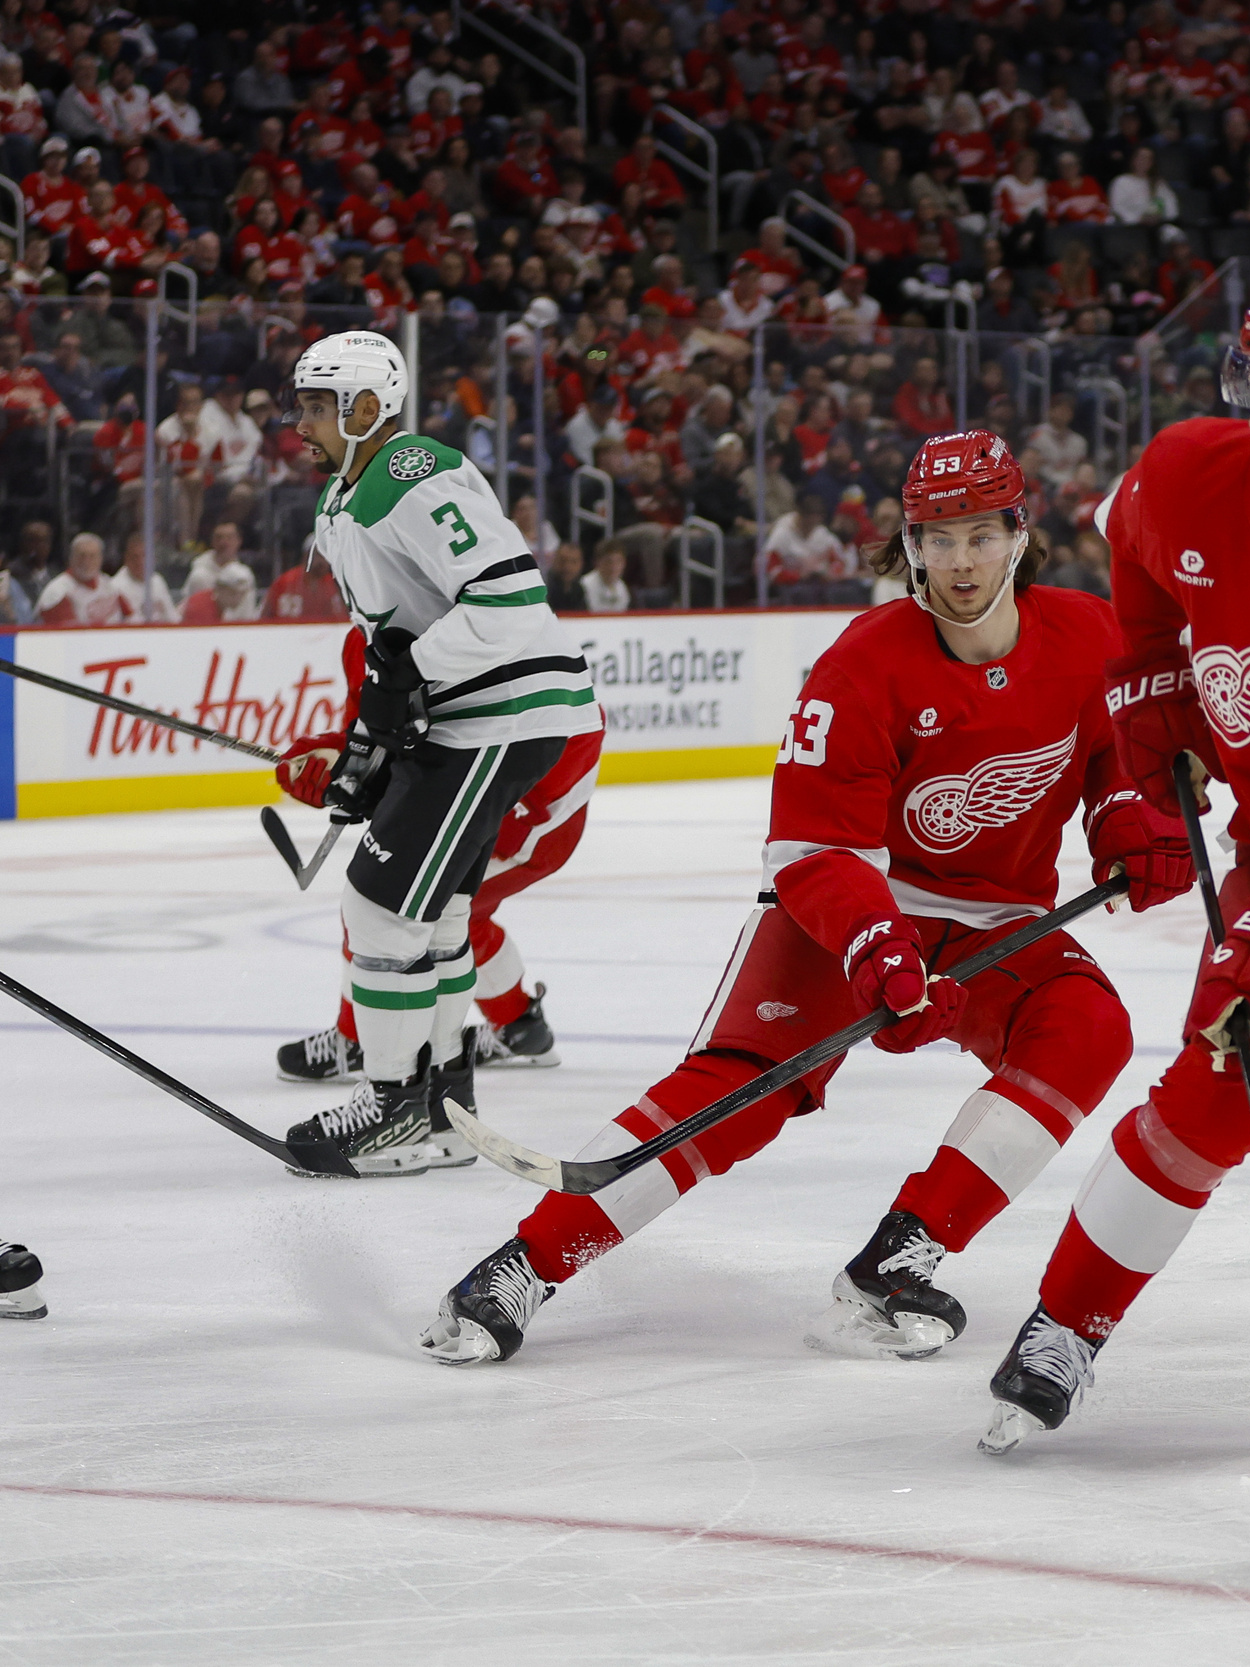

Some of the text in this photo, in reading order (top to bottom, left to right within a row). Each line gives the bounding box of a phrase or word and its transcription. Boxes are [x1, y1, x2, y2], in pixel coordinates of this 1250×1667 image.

[932, 456, 961, 476] 53
[928, 487, 967, 500] BAUER
[430, 501, 478, 557] 3
[1173, 569, 1215, 588] PRIORITY
[606, 699, 721, 730] NSURANCE
[363, 830, 393, 863] CM
[358, 1113, 414, 1156] CCM
